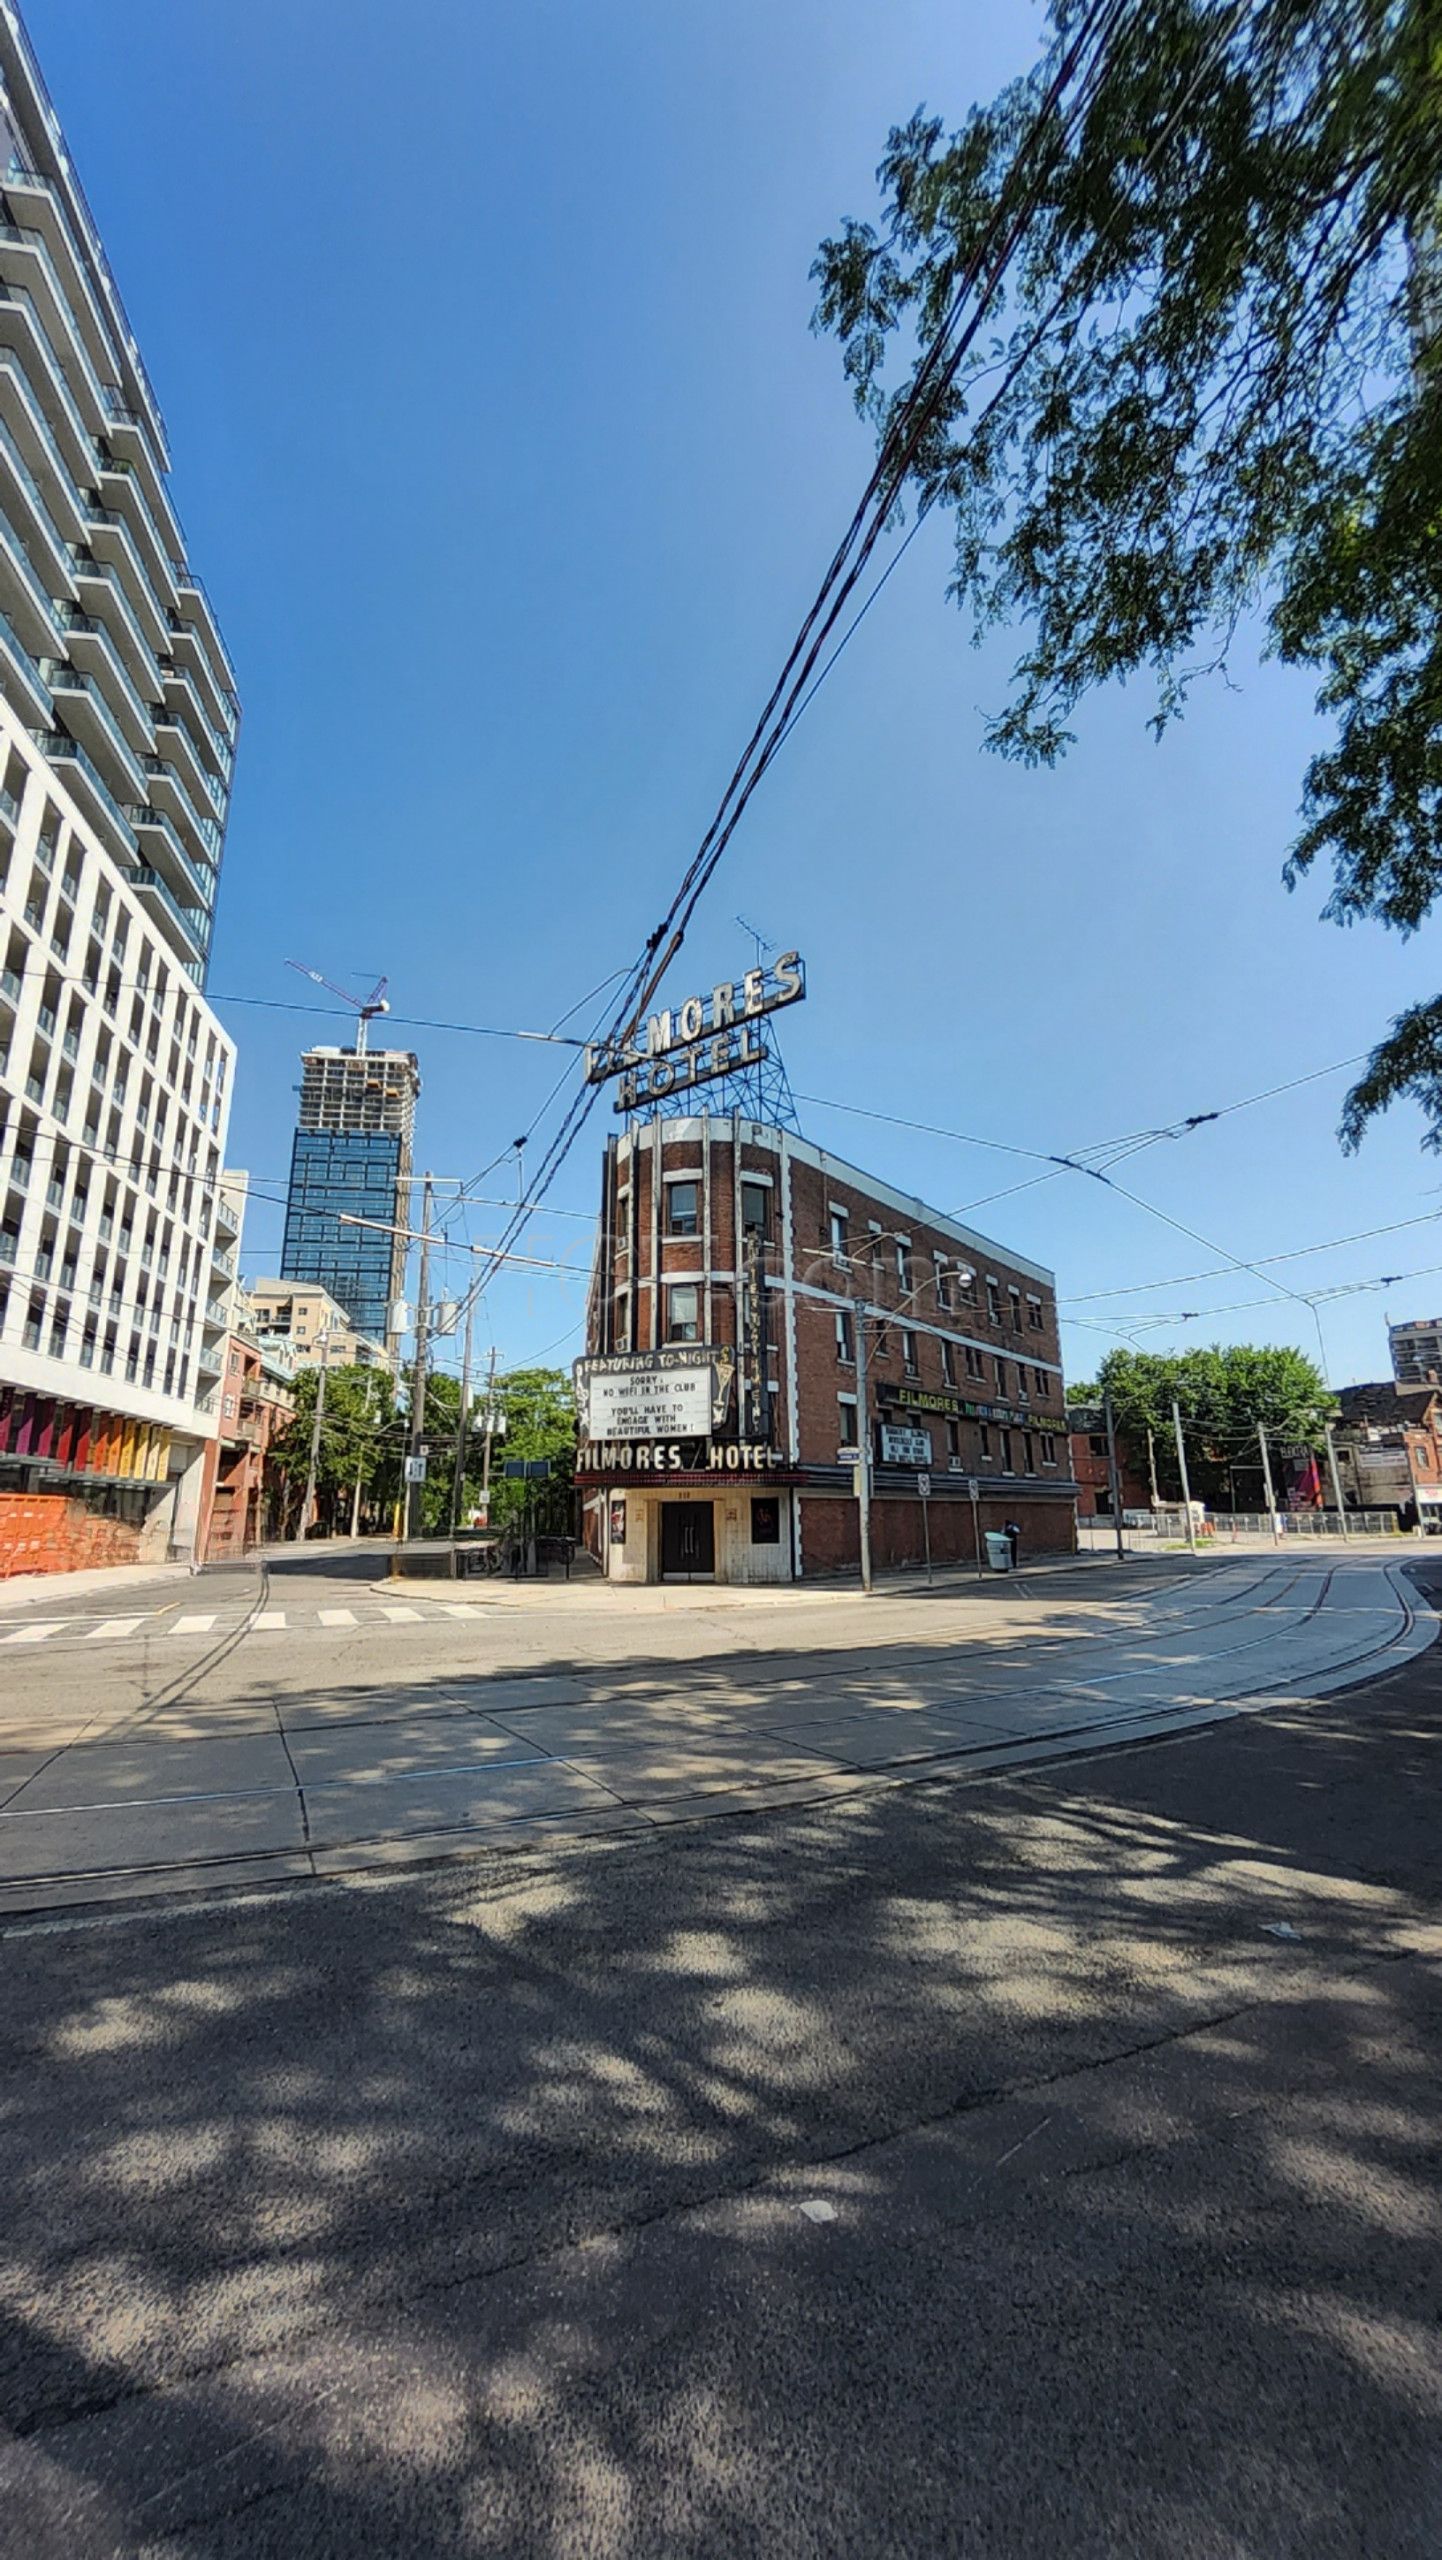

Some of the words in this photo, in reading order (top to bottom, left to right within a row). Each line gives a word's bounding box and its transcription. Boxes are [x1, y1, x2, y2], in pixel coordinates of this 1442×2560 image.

[618, 1027, 760, 1106] HOTEL
[584, 1354, 654, 1373] FEATURING
[603, 1388, 614, 1397] NO
[618, 1386, 638, 1398] WIFI
[641, 1386, 650, 1395] IN
[653, 1384, 669, 1395] THE
[674, 1382, 696, 1393] CLUB
[644, 1404, 666, 1415] HAVE
[672, 1403, 683, 1413] TO
[899, 1388, 960, 1414] FILMORES
[654, 1413, 676, 1423] WITH
[607, 1425, 651, 1437] BEAUTIFUL
[576, 1444, 682, 1473] FILMORES
[709, 1444, 776, 1471] HOTEL
